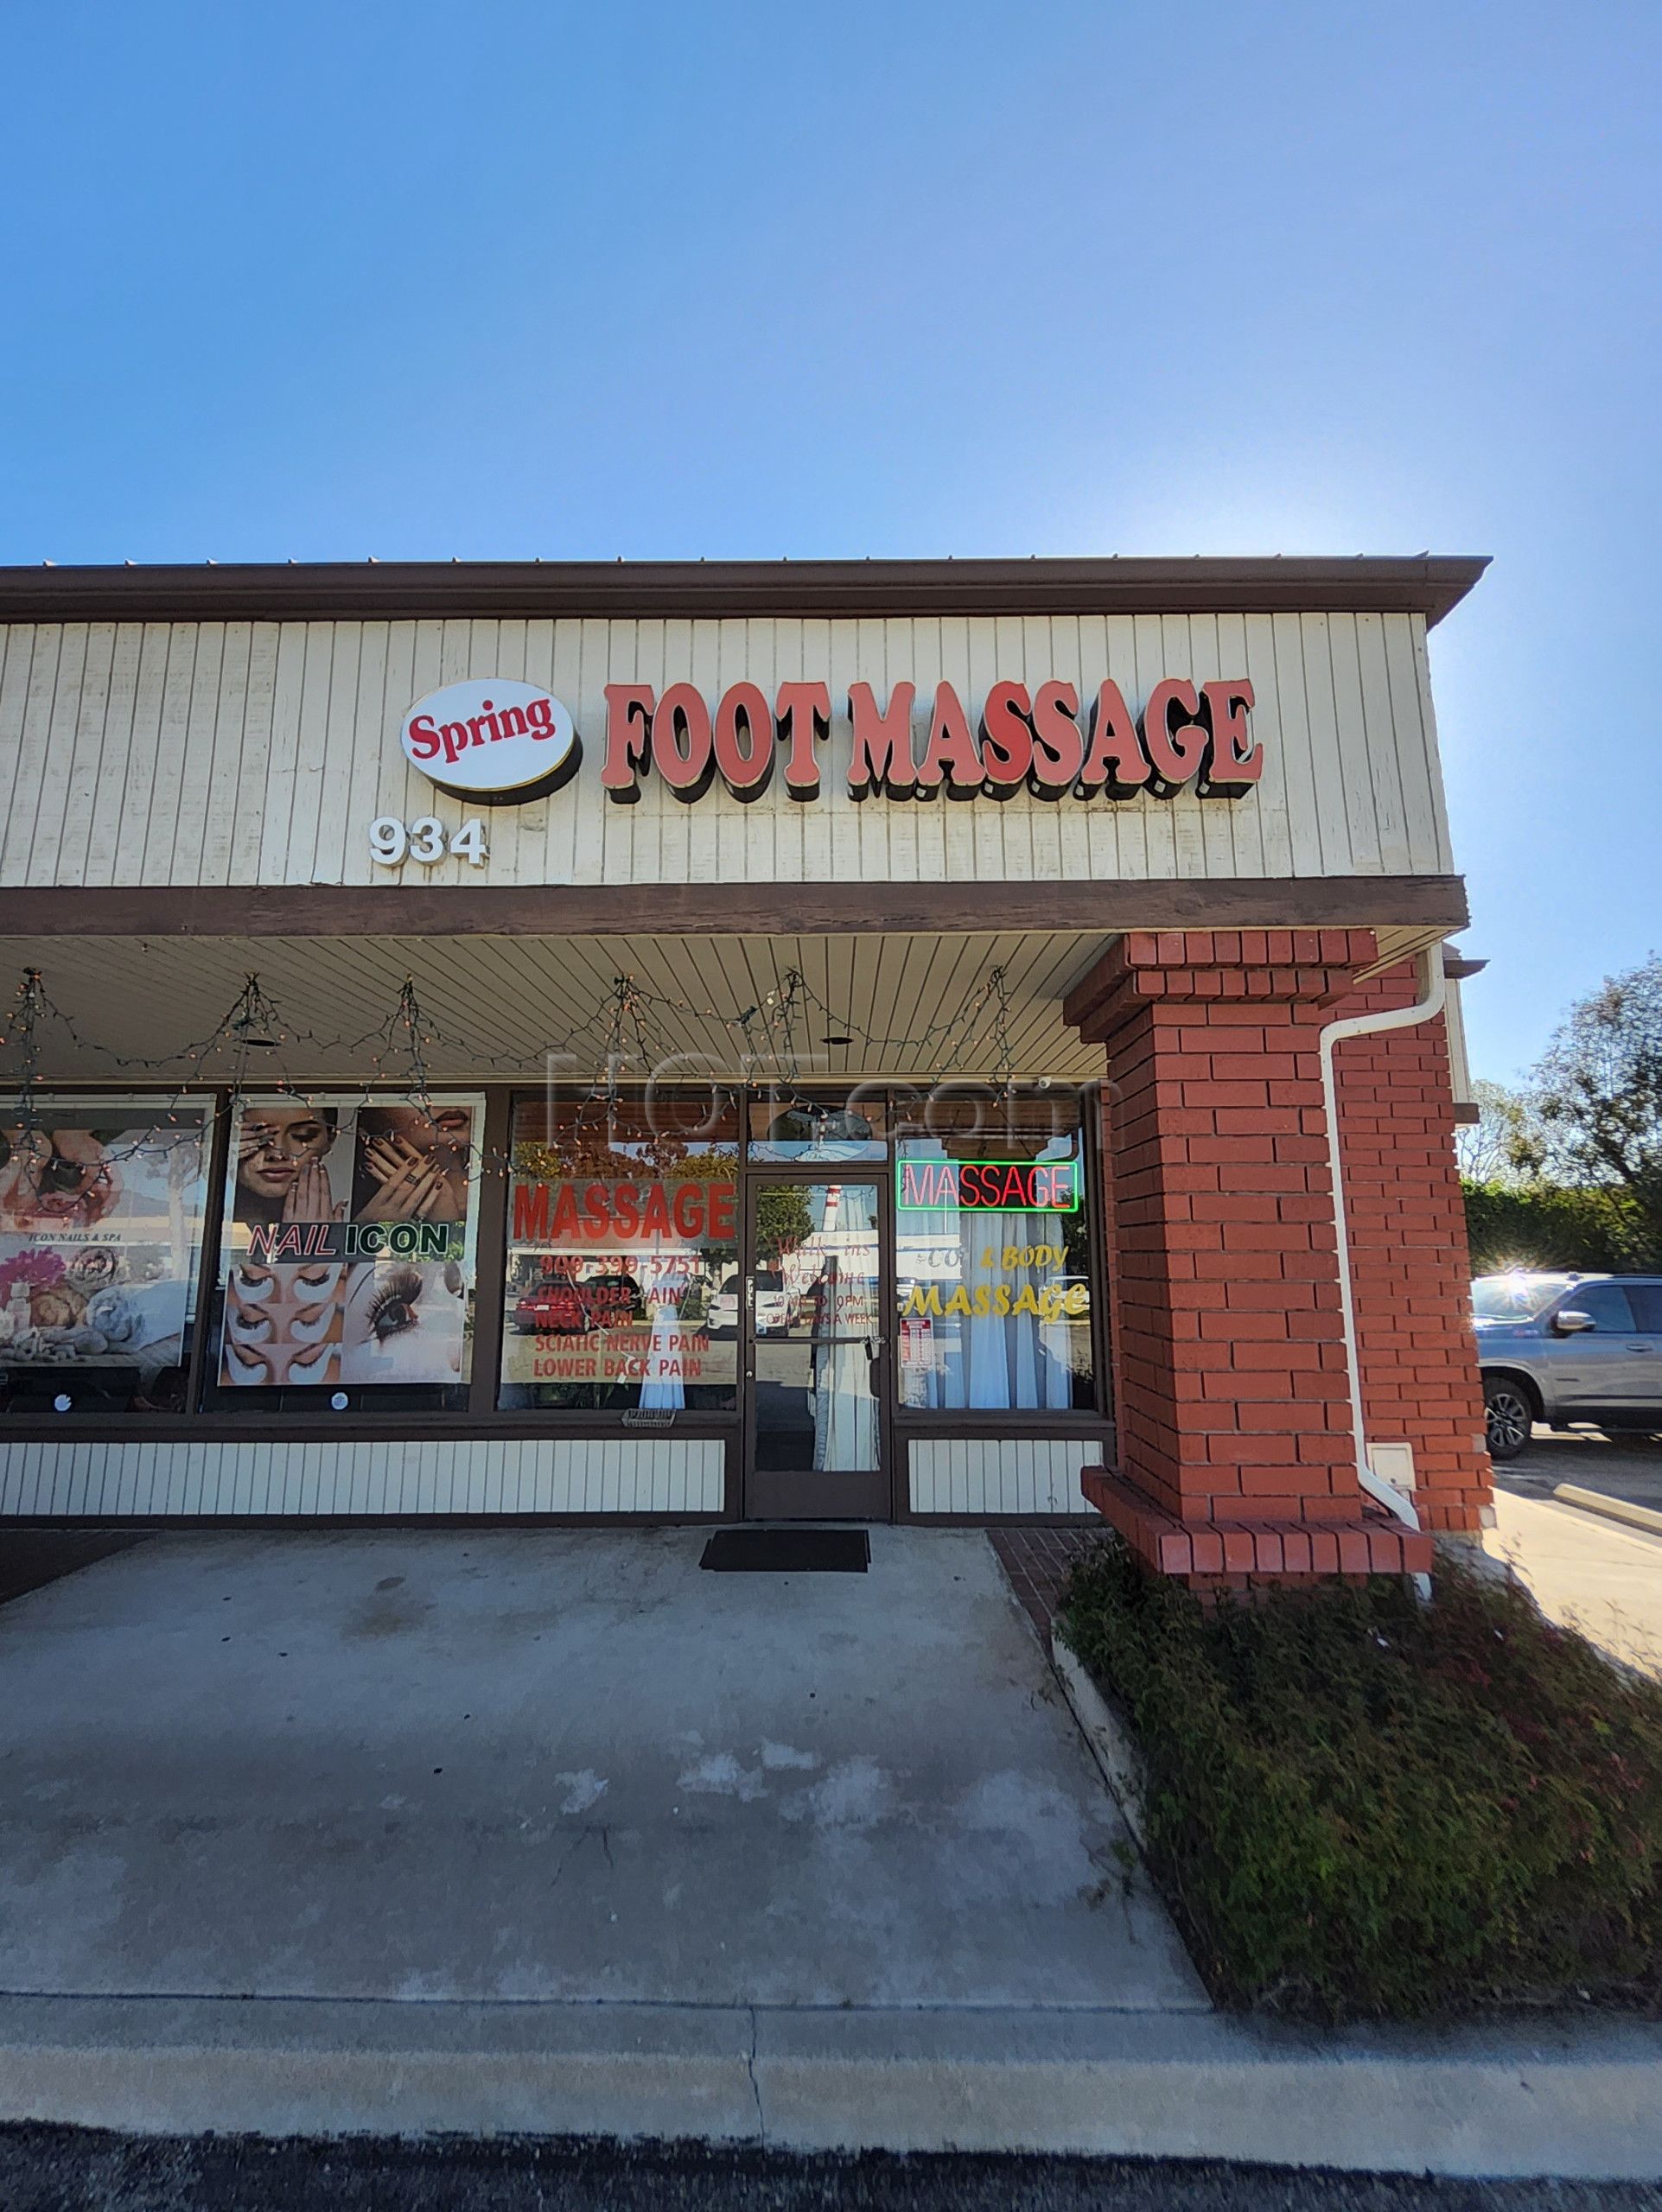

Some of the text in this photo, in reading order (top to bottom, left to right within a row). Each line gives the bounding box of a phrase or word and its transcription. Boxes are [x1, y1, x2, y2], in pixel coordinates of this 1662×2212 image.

[408, 698, 557, 764] Spring
[601, 678, 1264, 793] FOOT MASSAGE
[369, 817, 488, 866] 934
[903, 1163, 1071, 1209] MASSAGE
[513, 1182, 736, 1241] MASSAGE
[29, 1233, 56, 1242] ICON
[57, 1233, 90, 1242] NAILS
[102, 1233, 121, 1242] SPA
[246, 1224, 449, 1256] NAIL ICON
[1002, 1244, 1070, 1271] BODY
[538, 1287, 632, 1305] SHOULDER
[535, 1310, 634, 1328] NECK PAIN
[844, 1313, 873, 1325] WEEK
[535, 1334, 710, 1353] SCIATIC NERVE PAIN
[533, 1358, 702, 1377] LOWER BACK PAIN
